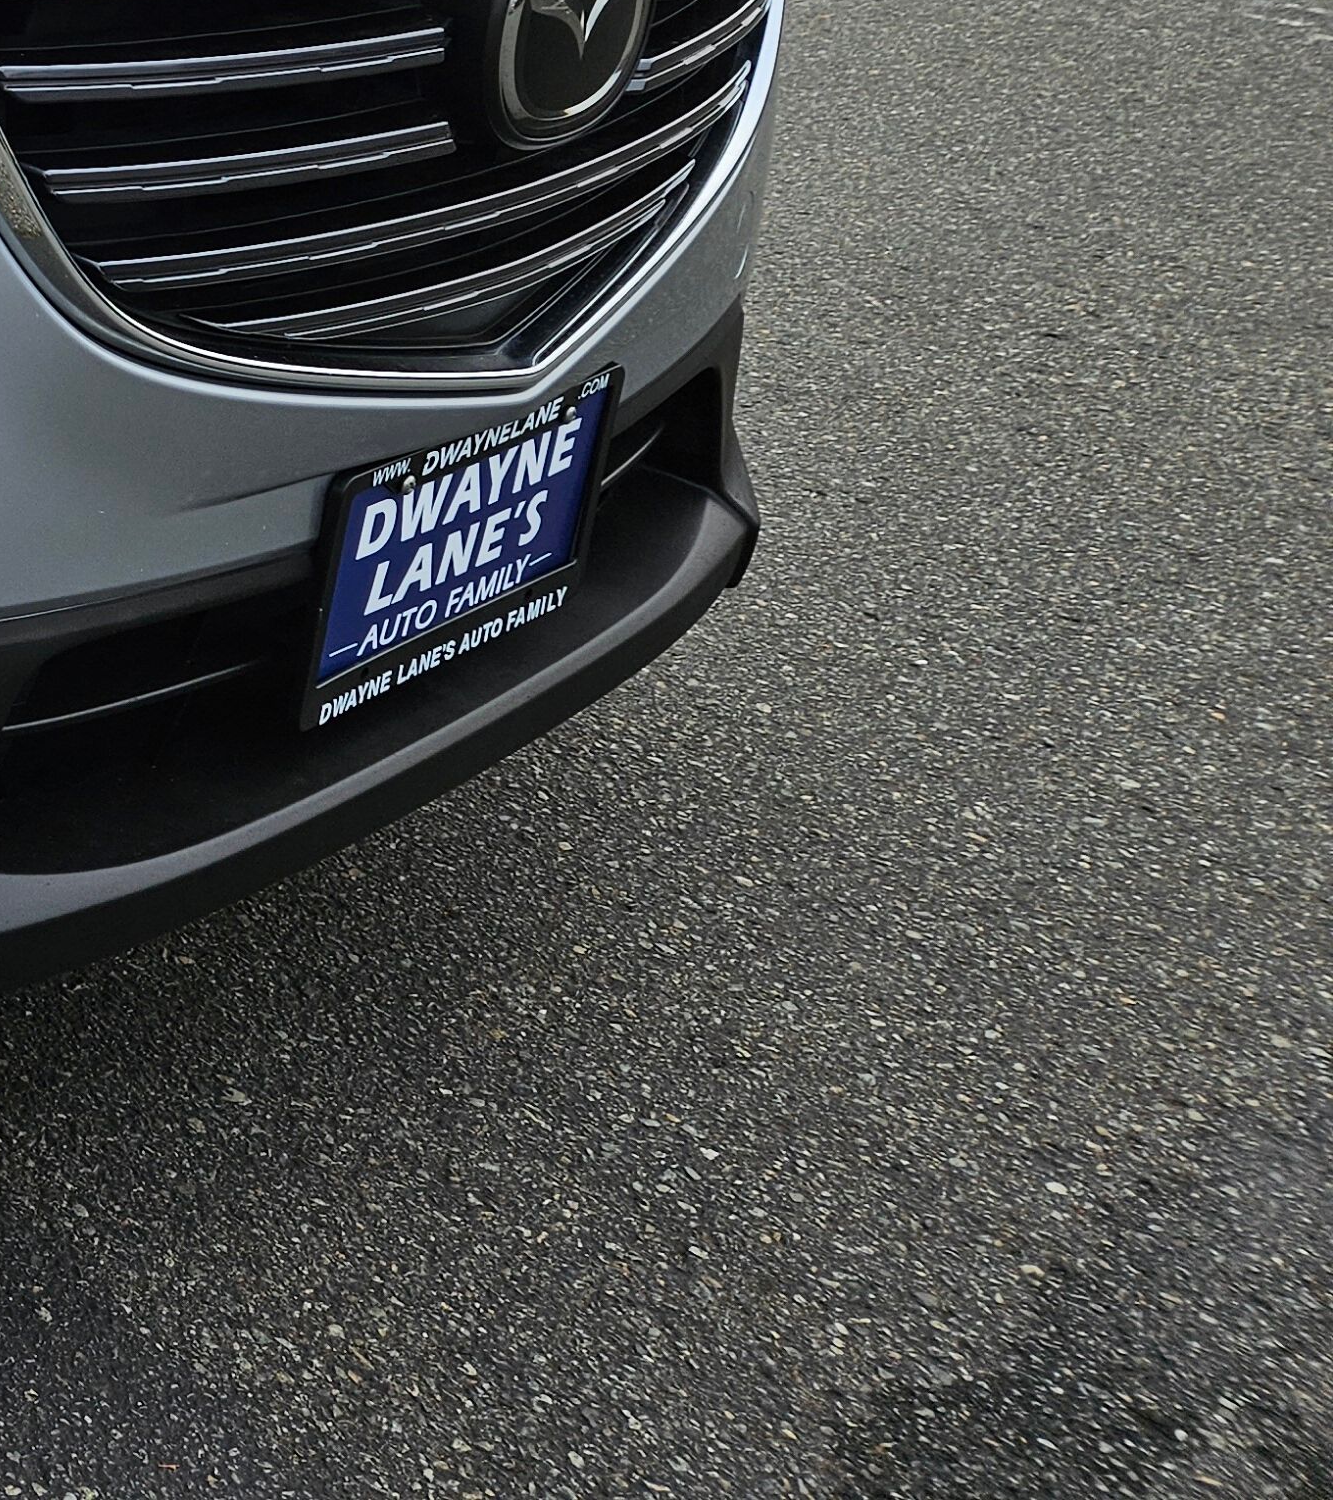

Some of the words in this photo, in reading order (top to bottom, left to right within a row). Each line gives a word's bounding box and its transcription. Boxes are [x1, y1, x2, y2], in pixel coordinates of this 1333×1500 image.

[355, 418, 582, 561] DWAYNE
[373, 457, 411, 487] WWW.
[422, 396, 565, 476] DWAYNELANE
[578, 373, 610, 400] .COM
[356, 599, 438, 657] AUTO
[444, 553, 531, 618] FAMILY
[364, 490, 548, 616] LANE'S
[319, 669, 393, 726] DWAYNE
[396, 640, 457, 685] LANE'S
[458, 617, 503, 655] AUTO
[505, 586, 568, 632] FAMILY
